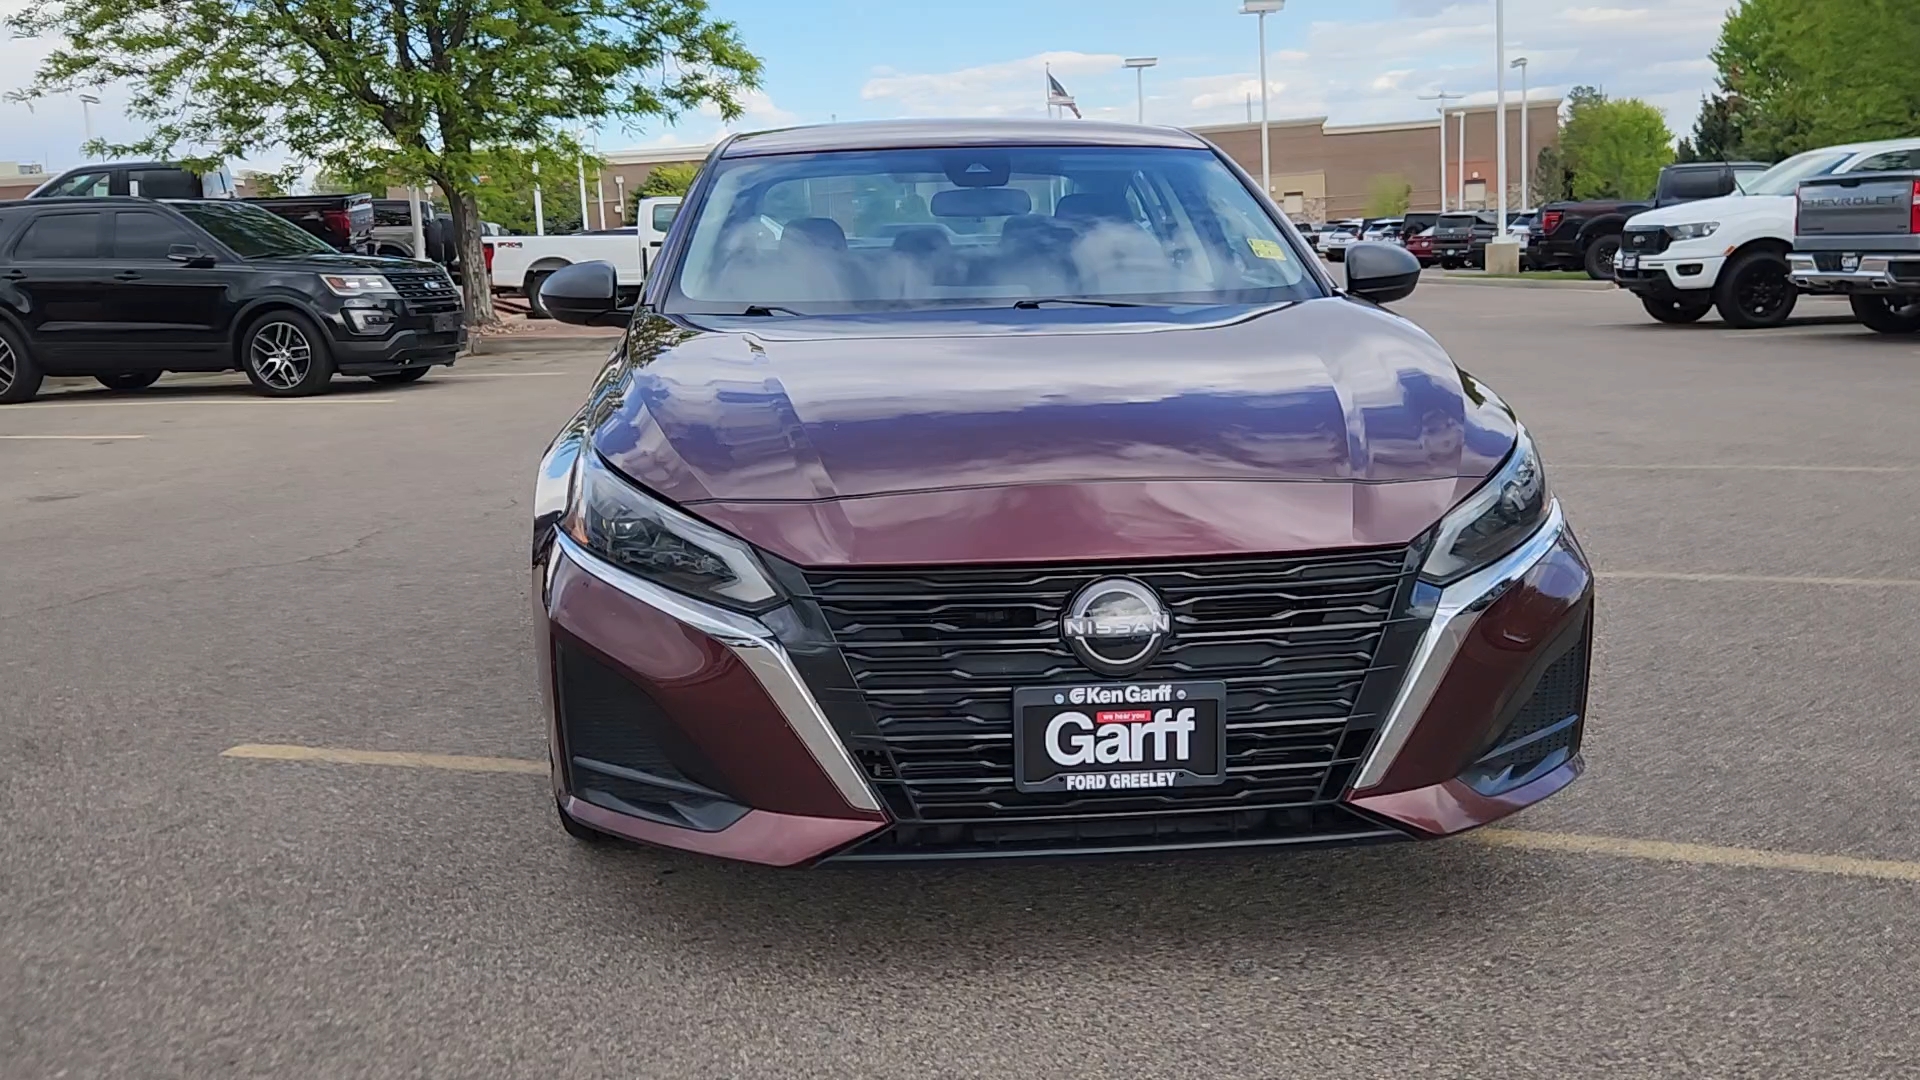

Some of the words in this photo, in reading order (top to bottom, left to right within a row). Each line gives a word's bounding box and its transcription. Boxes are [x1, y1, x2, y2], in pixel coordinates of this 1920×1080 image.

[1801, 195, 1898, 207] CHEVROLET
[1066, 614, 1170, 635] NISSAN
[1086, 685, 1124, 704] Ken
[1125, 684, 1172, 703] Garff
[1114, 712, 1130, 720] hear
[1131, 713, 1146, 721] you
[1044, 708, 1196, 766] Garff
[1066, 775, 1106, 790] FORD
[1109, 772, 1176, 789] GREELEY
